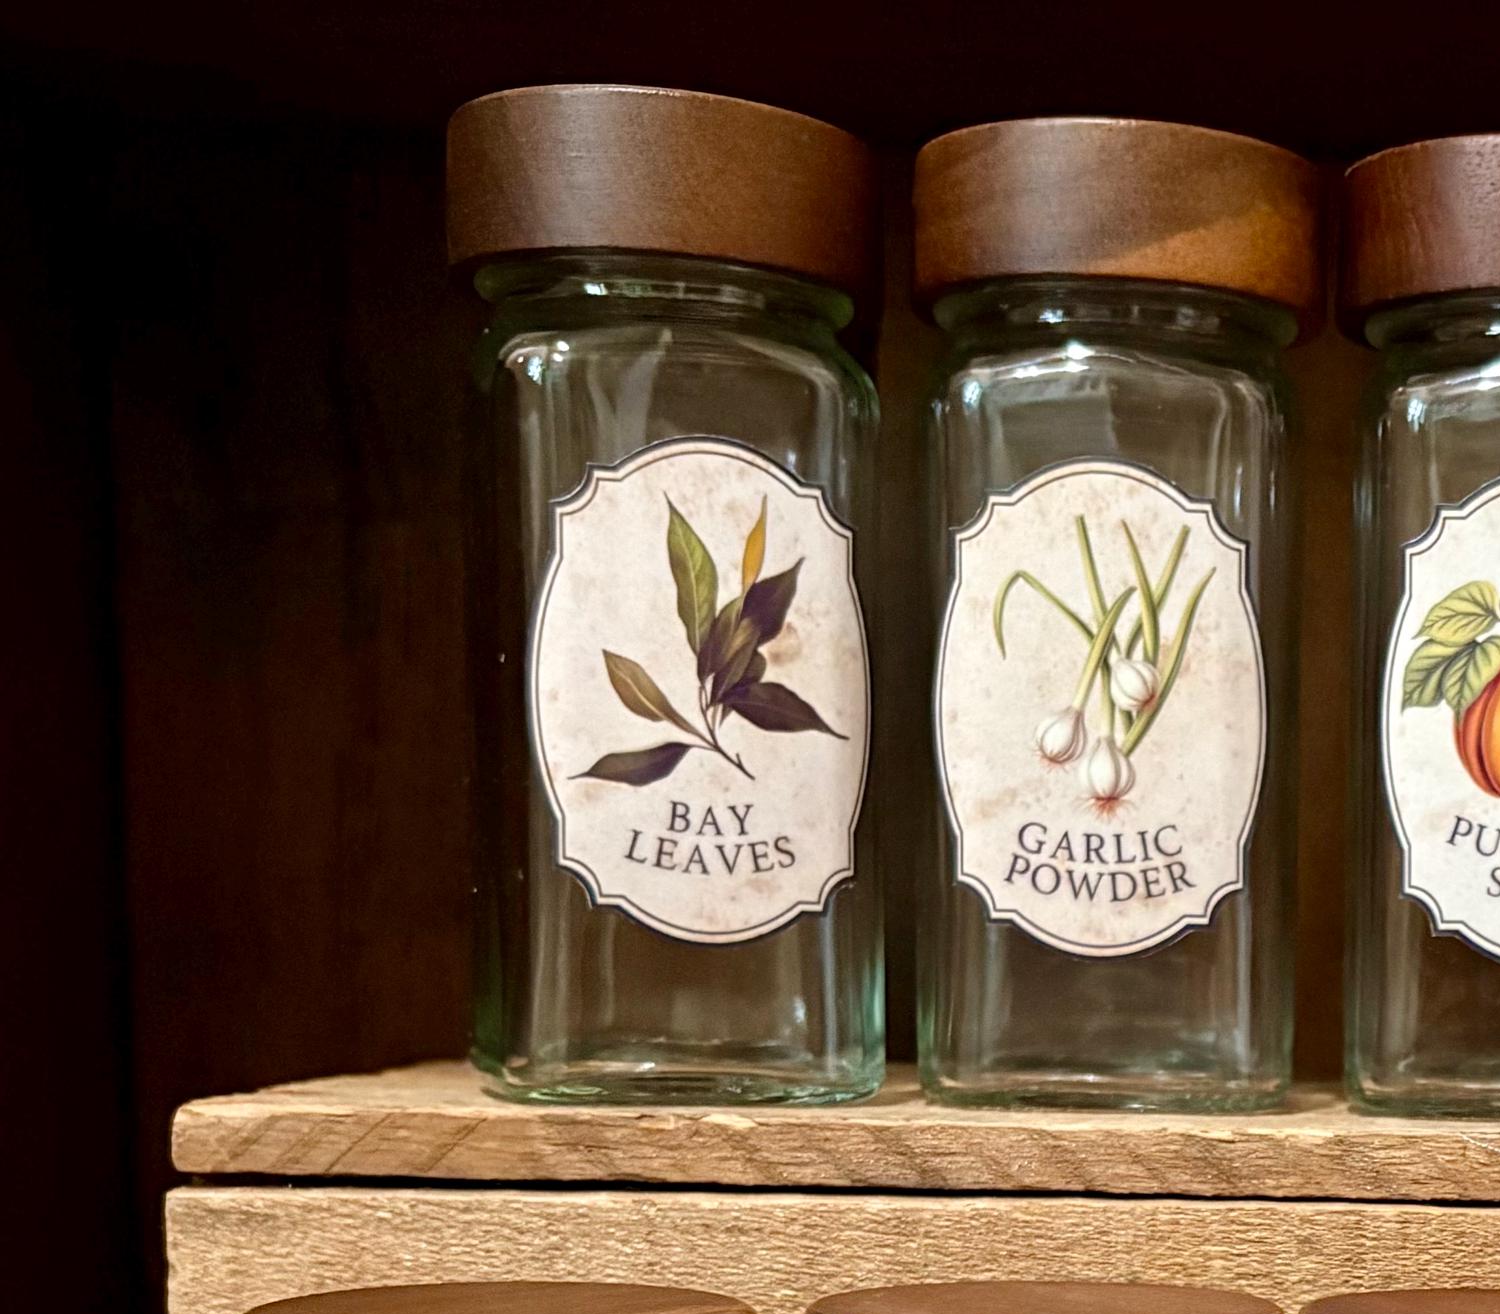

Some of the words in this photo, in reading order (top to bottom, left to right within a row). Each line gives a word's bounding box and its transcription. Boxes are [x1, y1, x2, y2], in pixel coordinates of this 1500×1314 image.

[666, 800, 753, 836] BAY
[624, 829, 796, 875] LEAVES
[1018, 822, 1182, 864] GARLIC
[1004, 853, 1196, 902] POWDER
